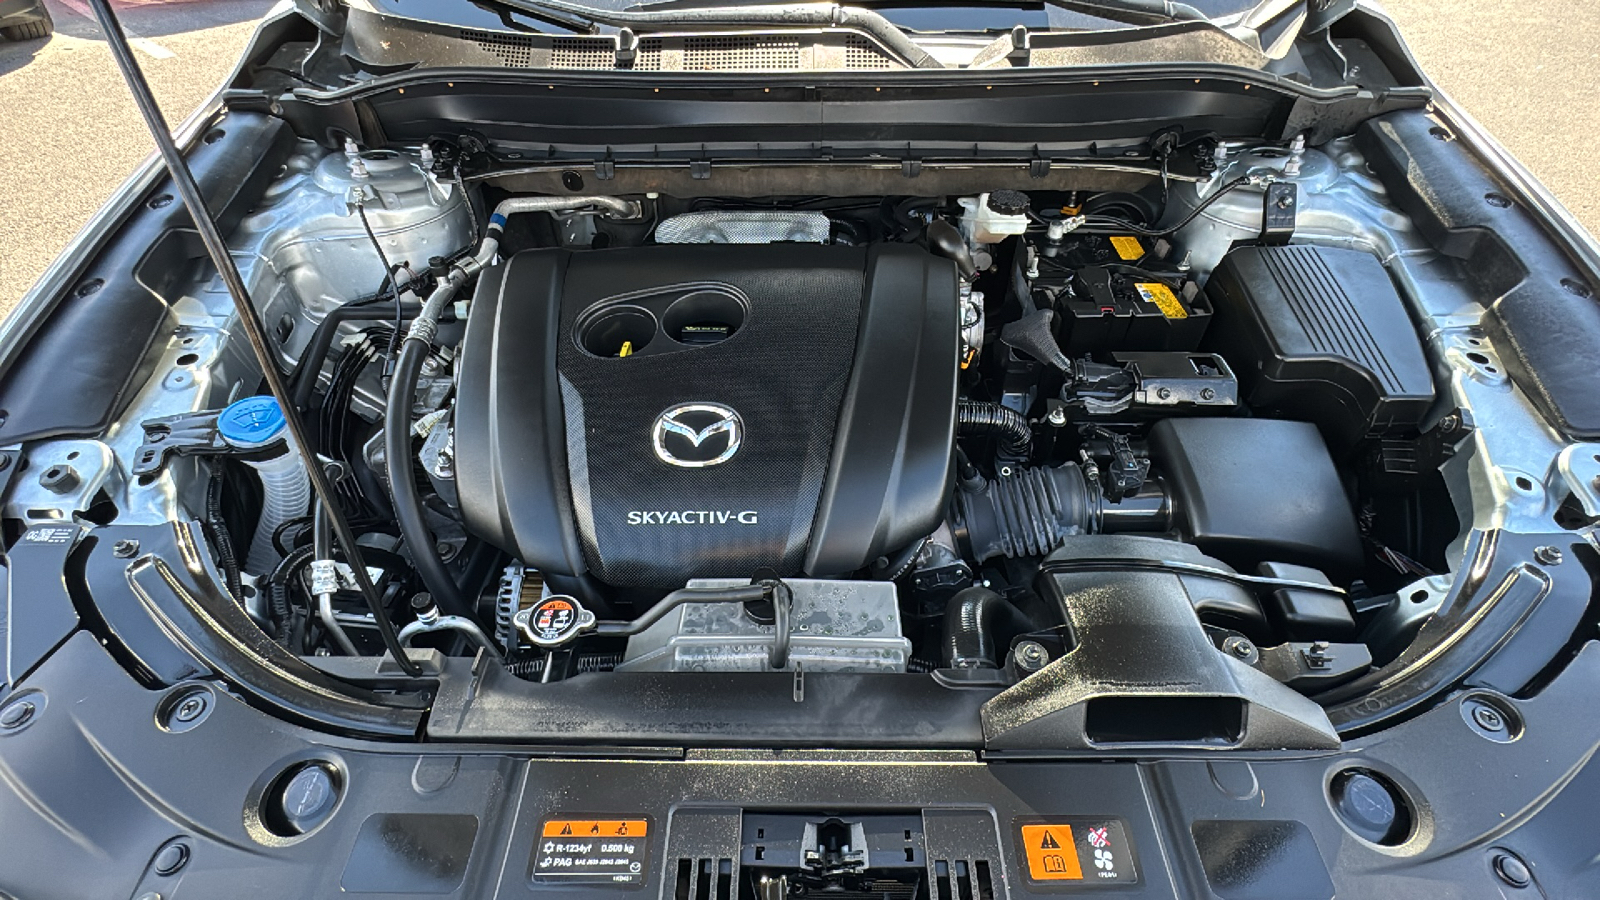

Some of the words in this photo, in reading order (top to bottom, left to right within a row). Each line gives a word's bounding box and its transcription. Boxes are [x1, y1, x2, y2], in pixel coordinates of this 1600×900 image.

[627, 511, 758, 525] SKYACTIV-G
[556, 844, 592, 854] R-1234yf
[624, 844, 635, 854] kg
[553, 858, 572, 867] PAG
